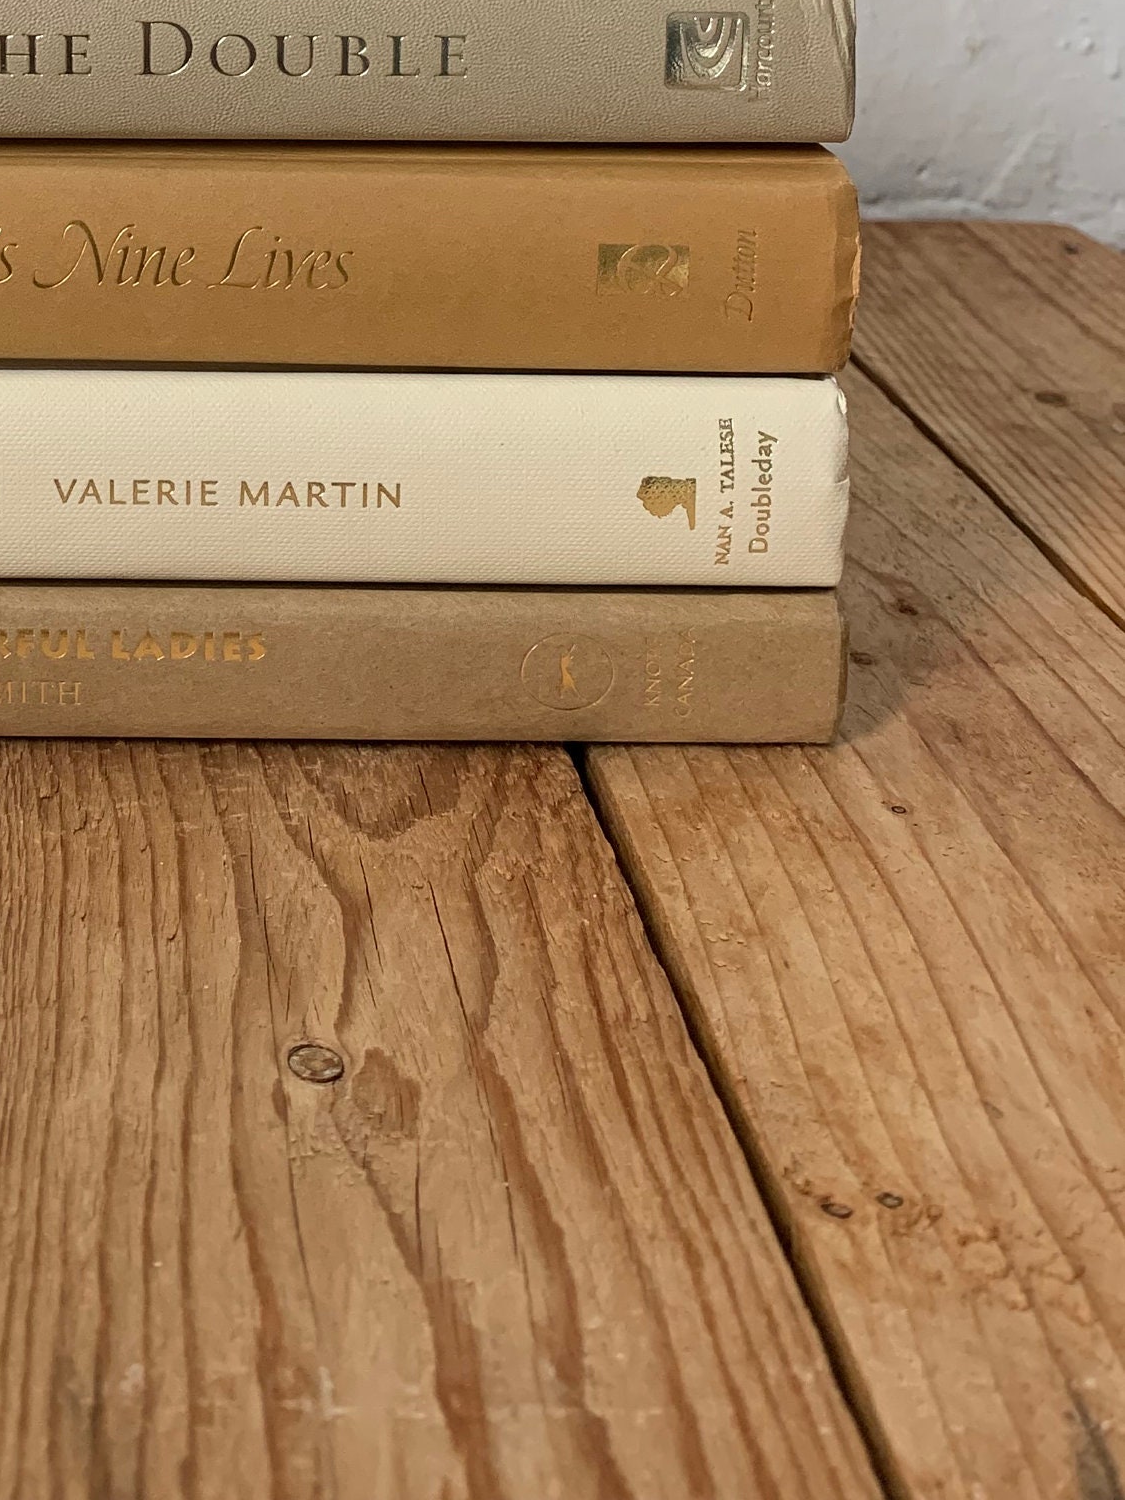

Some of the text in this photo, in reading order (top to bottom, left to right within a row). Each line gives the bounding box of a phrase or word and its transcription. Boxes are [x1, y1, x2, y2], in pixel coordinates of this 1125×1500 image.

[135, 18, 469, 80] DOUBLE
[748, 0, 776, 102] Harcourt
[33, 218, 195, 290] Nine
[206, 225, 355, 291] Lives
[725, 229, 759, 323] Dutton
[54, 477, 403, 509] VALERIE MARTIN
[718, 417, 736, 494] TALESE
[748, 429, 780, 555] Doubleday
[714, 525, 733, 566] NAN
[110, 628, 267, 662] LADIES
[675, 625, 696, 718] CANADA
